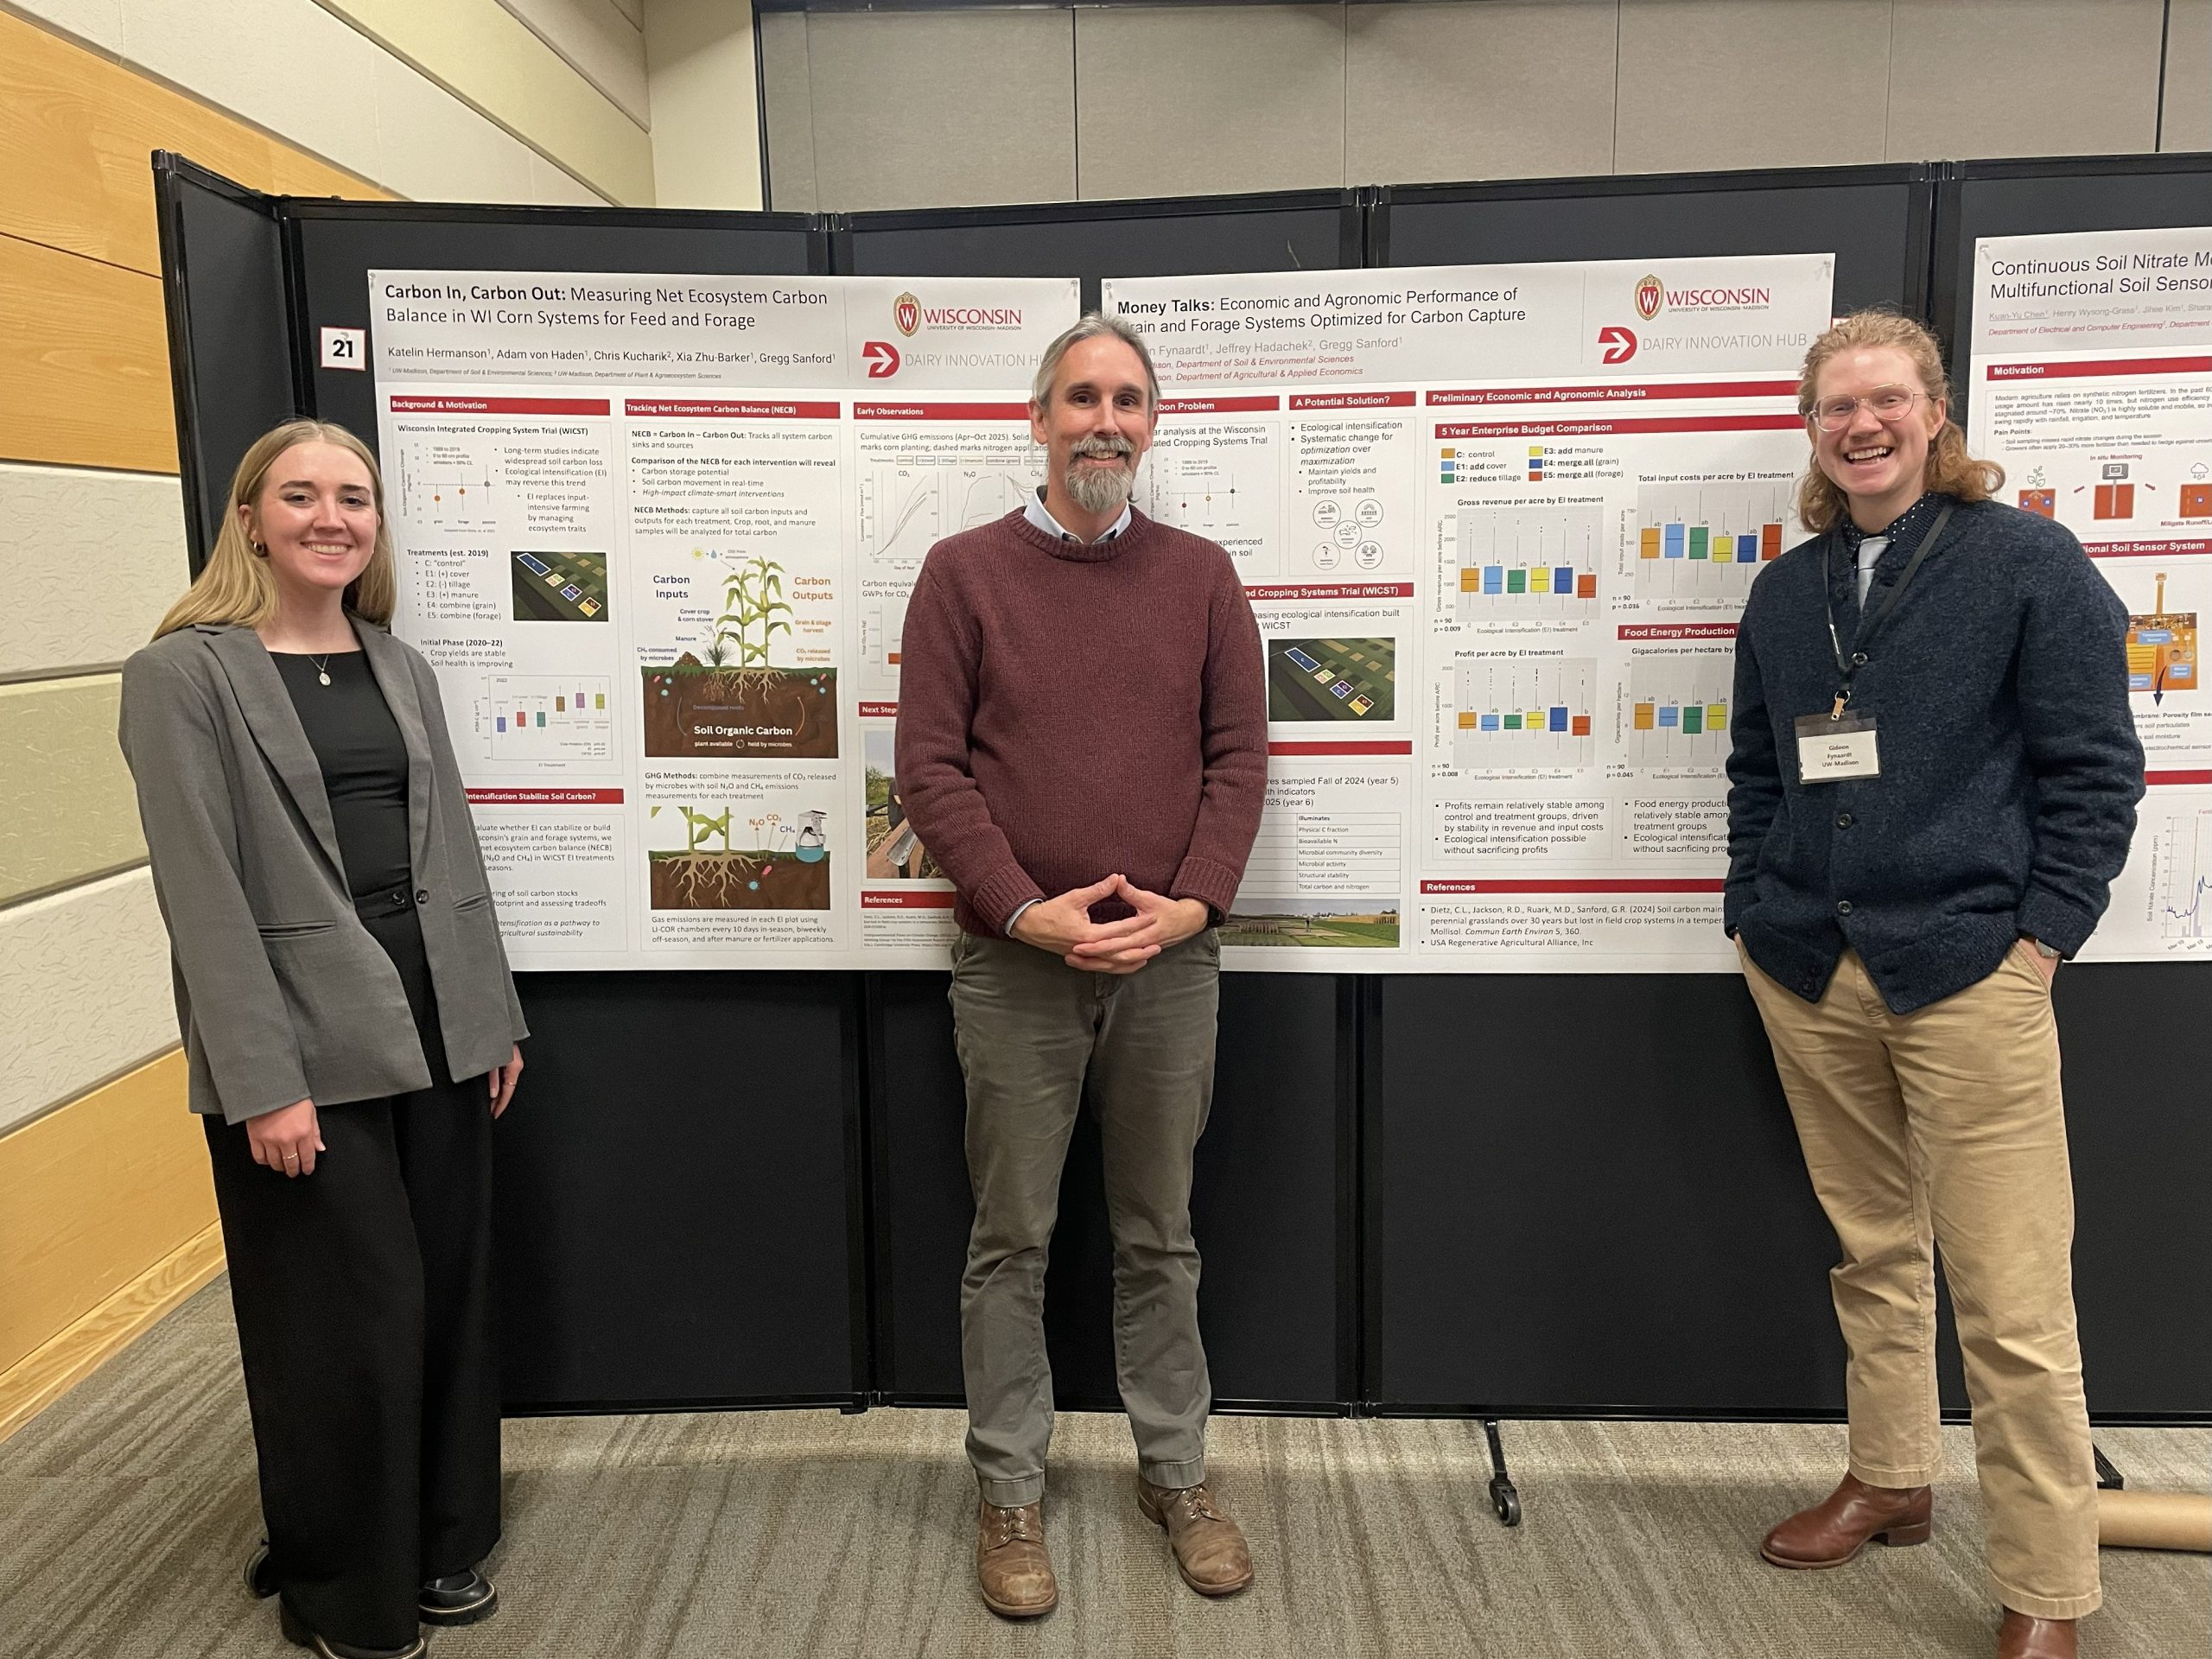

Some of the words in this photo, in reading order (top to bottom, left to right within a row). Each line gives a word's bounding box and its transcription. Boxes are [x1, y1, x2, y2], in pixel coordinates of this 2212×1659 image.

[1992, 259, 2089, 276] Continuous
[2095, 255, 2126, 270] Soil
[2133, 253, 2188, 269] Nitrate
[1991, 278, 2113, 298] Multifunctional
[2119, 276, 2150, 292] Soil
[385, 283, 442, 298] Carbon
[446, 285, 466, 302] In,
[471, 285, 526, 300] Carbon
[531, 286, 565, 300] Out:
[570, 287, 652, 305] Measuring
[656, 289, 683, 302] Net
[688, 289, 767, 306] Ecosystem
[772, 289, 827, 304] Carbon
[1666, 288, 1770, 306] WISCONSIN
[1117, 301, 1166, 315] Money
[1171, 298, 1214, 312] Talks:
[1220, 296, 1289, 310] Economic
[1294, 294, 1319, 308] and
[1324, 291, 1402, 309] Agronomic
[1407, 289, 1498, 303] Performance
[1503, 287, 1518, 300] of
[386, 307, 447, 322] Balance
[452, 308, 465, 322] in
[470, 309, 491, 323] WI
[497, 309, 532, 323] Corn
[537, 310, 599, 327] Systems
[603, 310, 625, 325] for
[630, 311, 665, 326] Feed
[671, 312, 699, 326] and
[704, 313, 754, 330] Forage
[923, 308, 1020, 324] WISCONSIN
[1130, 321, 1155, 334] rain
[1160, 319, 1185, 332] and
[1191, 318, 1240, 334] Forage
[1245, 316, 1305, 332] Systems
[1310, 311, 1382, 329] Optimized
[1387, 311, 1406, 324] for
[1410, 309, 1463, 323] Carbon
[1468, 308, 1525, 324] Capture
[1643, 337, 1682, 351] DAIRY
[1686, 334, 1771, 349] INNOVATION
[1776, 333, 1807, 346] HUB
[333, 339, 353, 358] 21
[388, 346, 423, 357] Katelin
[496, 349, 526, 359] Adam
[594, 350, 620, 360] Chris
[676, 352, 692, 361] Xia
[760, 353, 789, 365] Gregg
[905, 353, 942, 366] DAIRY
[945, 353, 1025, 366] INNOVATION
[1993, 365, 2044, 375] Motivation
[1305, 397, 1344, 406] Potential
[1346, 395, 1389, 404] Solution?
[1432, 393, 1484, 403] Preliminary
[1486, 391, 1532, 401] Economic
[1534, 391, 1551, 399] and
[1553, 389, 1605, 400] Agronomic
[1605, 388, 1646, 398] Analysis
[391, 400, 436, 410] Background
[626, 404, 657, 414] Tracking
[673, 404, 711, 413] Ecosystem
[771, 405, 796, 415] (NECB)
[856, 407, 874, 416] Early
[436, 425, 475, 434] Integrated
[477, 426, 511, 435] Cropping
[512, 426, 539, 435] System
[559, 427, 588, 435] (WICST)
[1300, 423, 1343, 432] Ecological
[1345, 421, 1402, 429] intensification
[1441, 427, 1447, 435] 5
[1471, 425, 1519, 435] Enterprise
[1521, 424, 1554, 435] Budget
[1556, 423, 1612, 433] Comparison
[1300, 434, 1346, 444] Systematic
[1348, 434, 1379, 442] change
[1300, 446, 1351, 455] optimization
[2111, 543, 2130, 552] Soil
[2132, 543, 2167, 551] Sensor
[2169, 542, 2205, 551] System
[449, 549, 466, 557] (est.
[652, 575, 690, 583] Carbon
[794, 576, 830, 585] Carbon
[656, 589, 688, 600] Inputs
[792, 591, 833, 601] Outputs
[1650, 627, 1682, 638] Energy
[1684, 626, 1734, 635] Production
[694, 725, 713, 734] Soil
[715, 726, 753, 736] Organic
[755, 726, 792, 734] Carbon
[1445, 801, 1471, 810] Profits
[1506, 801, 1544, 810] relatively
[1537, 813, 1569, 822] groups,
